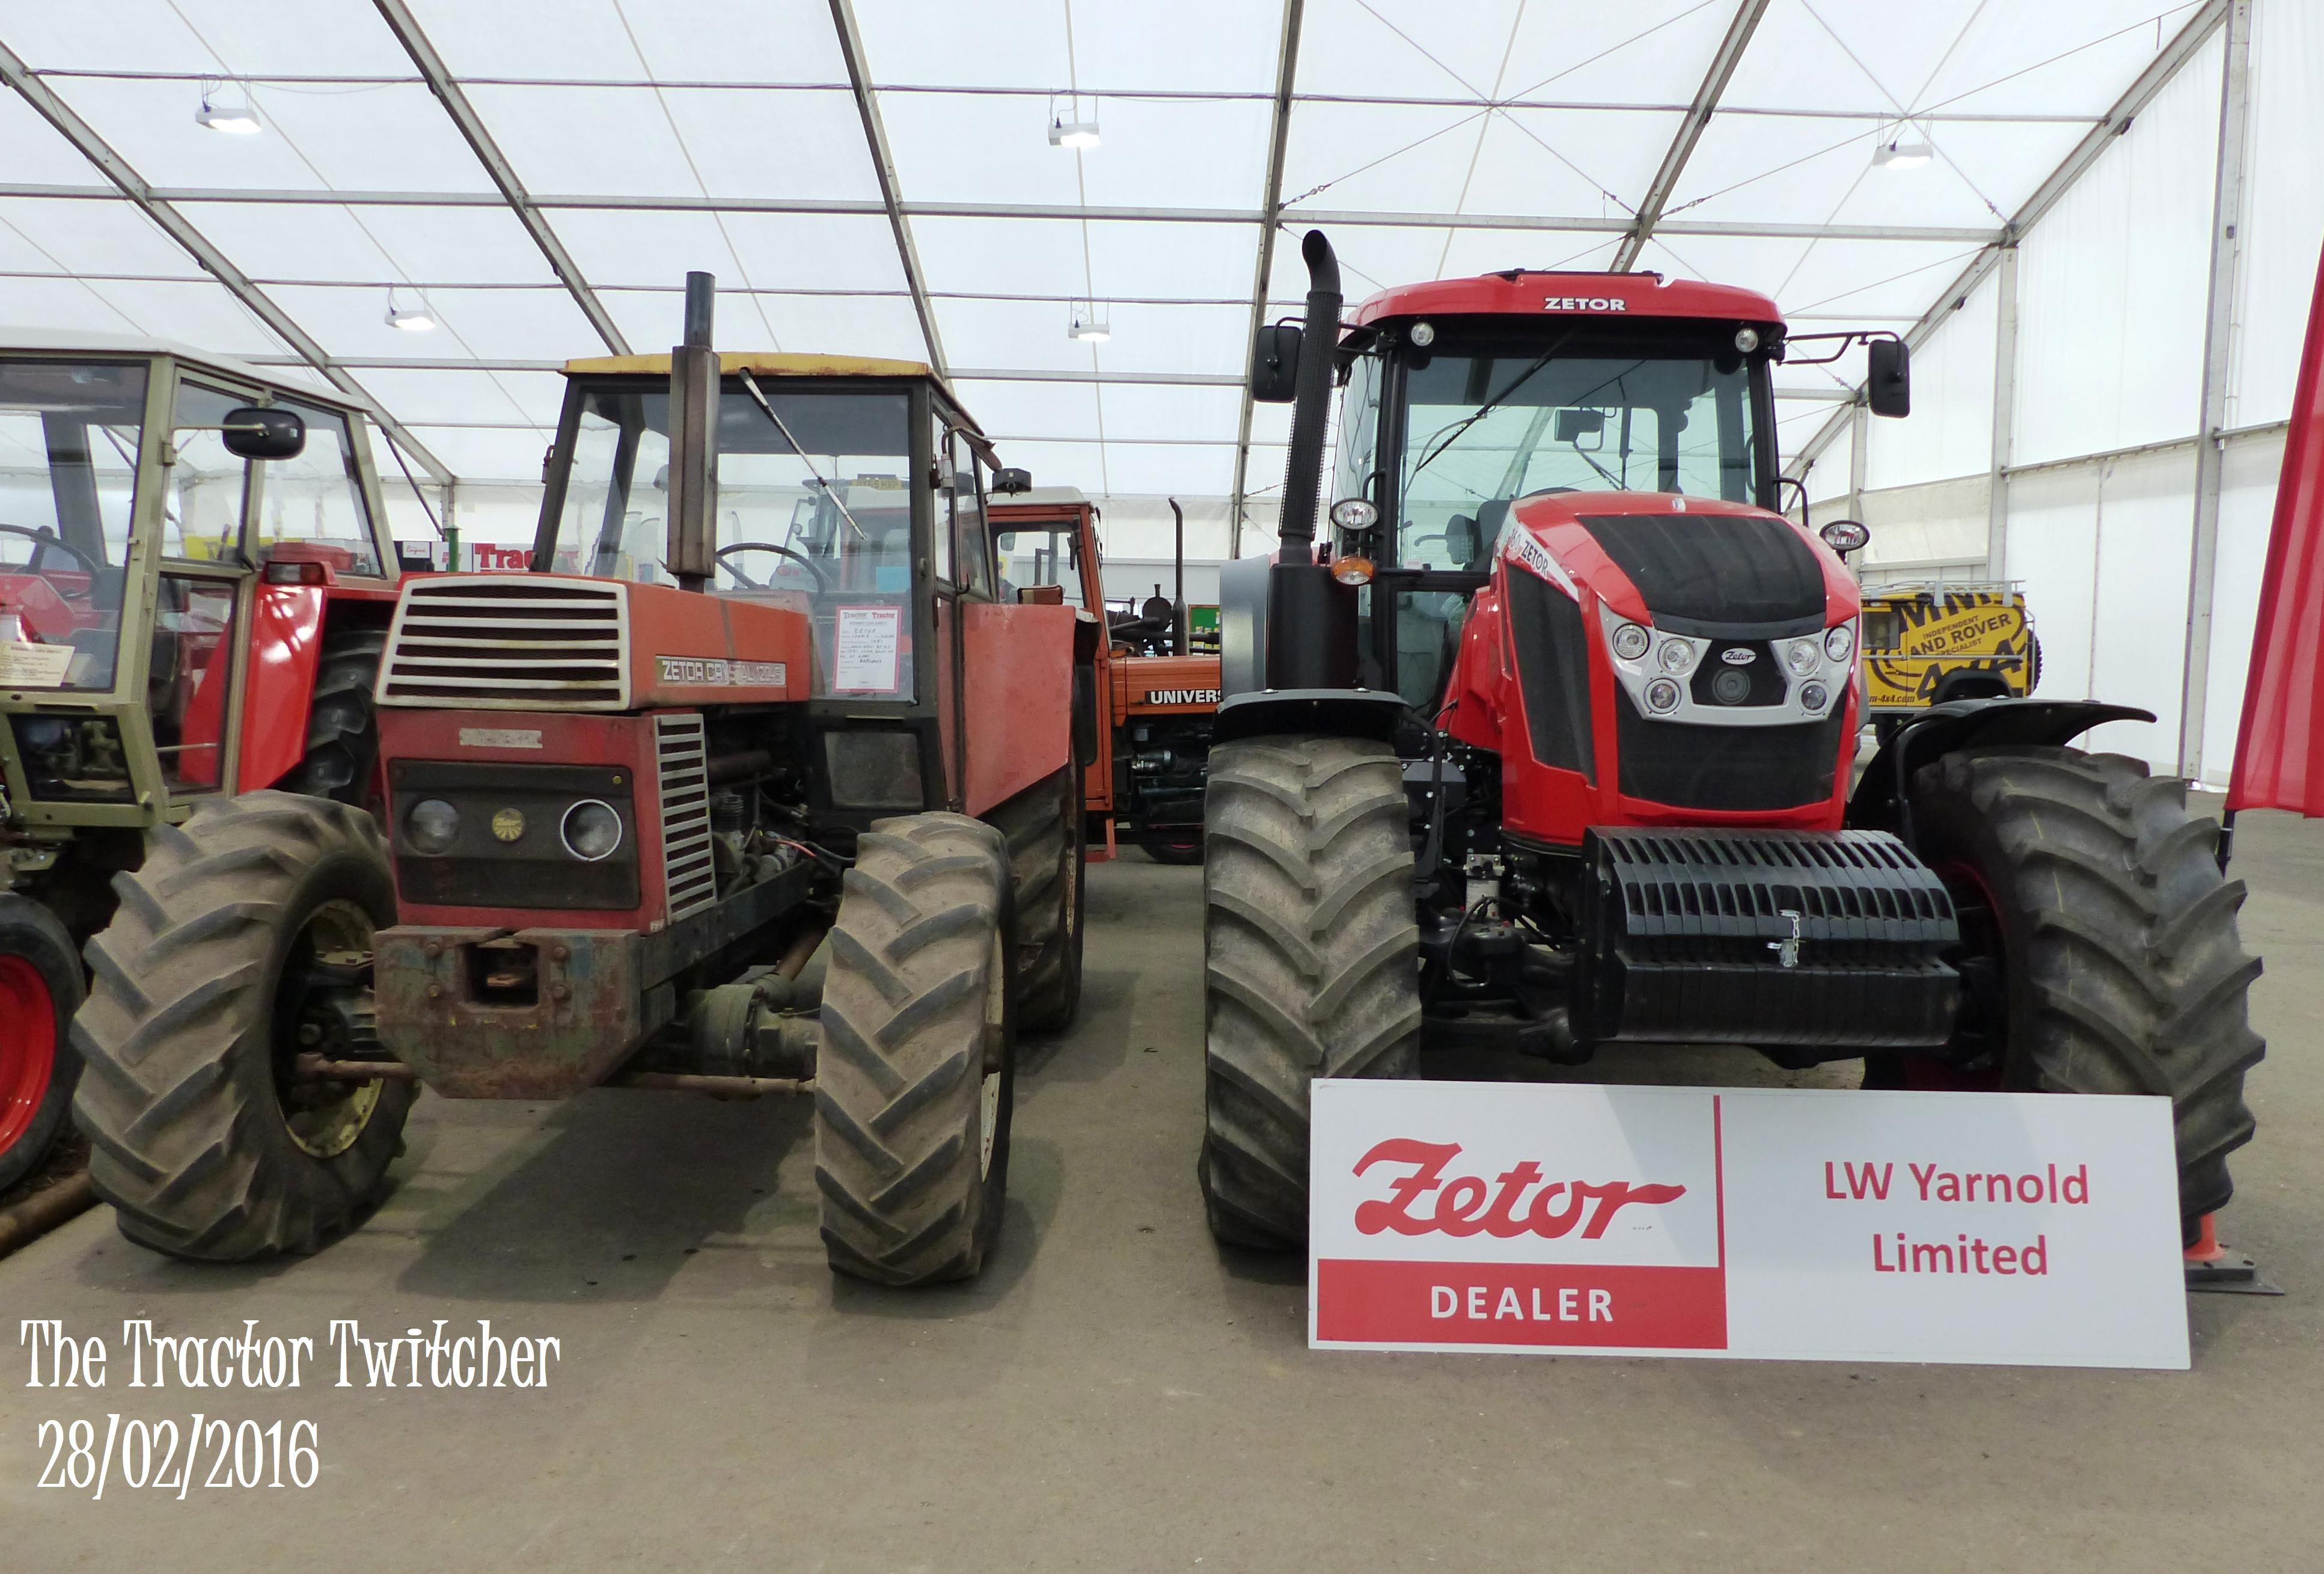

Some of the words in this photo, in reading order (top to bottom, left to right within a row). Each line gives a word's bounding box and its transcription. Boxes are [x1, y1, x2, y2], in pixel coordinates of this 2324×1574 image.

[1544, 297, 1625, 311] ZETOR
[1521, 540, 1549, 575] ZETOR
[1898, 636, 1946, 655] AND
[1951, 613, 2012, 645] ROVER
[1923, 615, 1980, 640] INDEPENDENT
[662, 660, 704, 682] ZETOR
[1725, 651, 1757, 660] Zetor
[1354, 1138, 1686, 1239] Zetor
[1826, 1162, 1892, 1200] LW
[1909, 1163, 2089, 1204] Yarnold
[1874, 1233, 2047, 1275] Limited
[1431, 1286, 1613, 1321] DEALER
